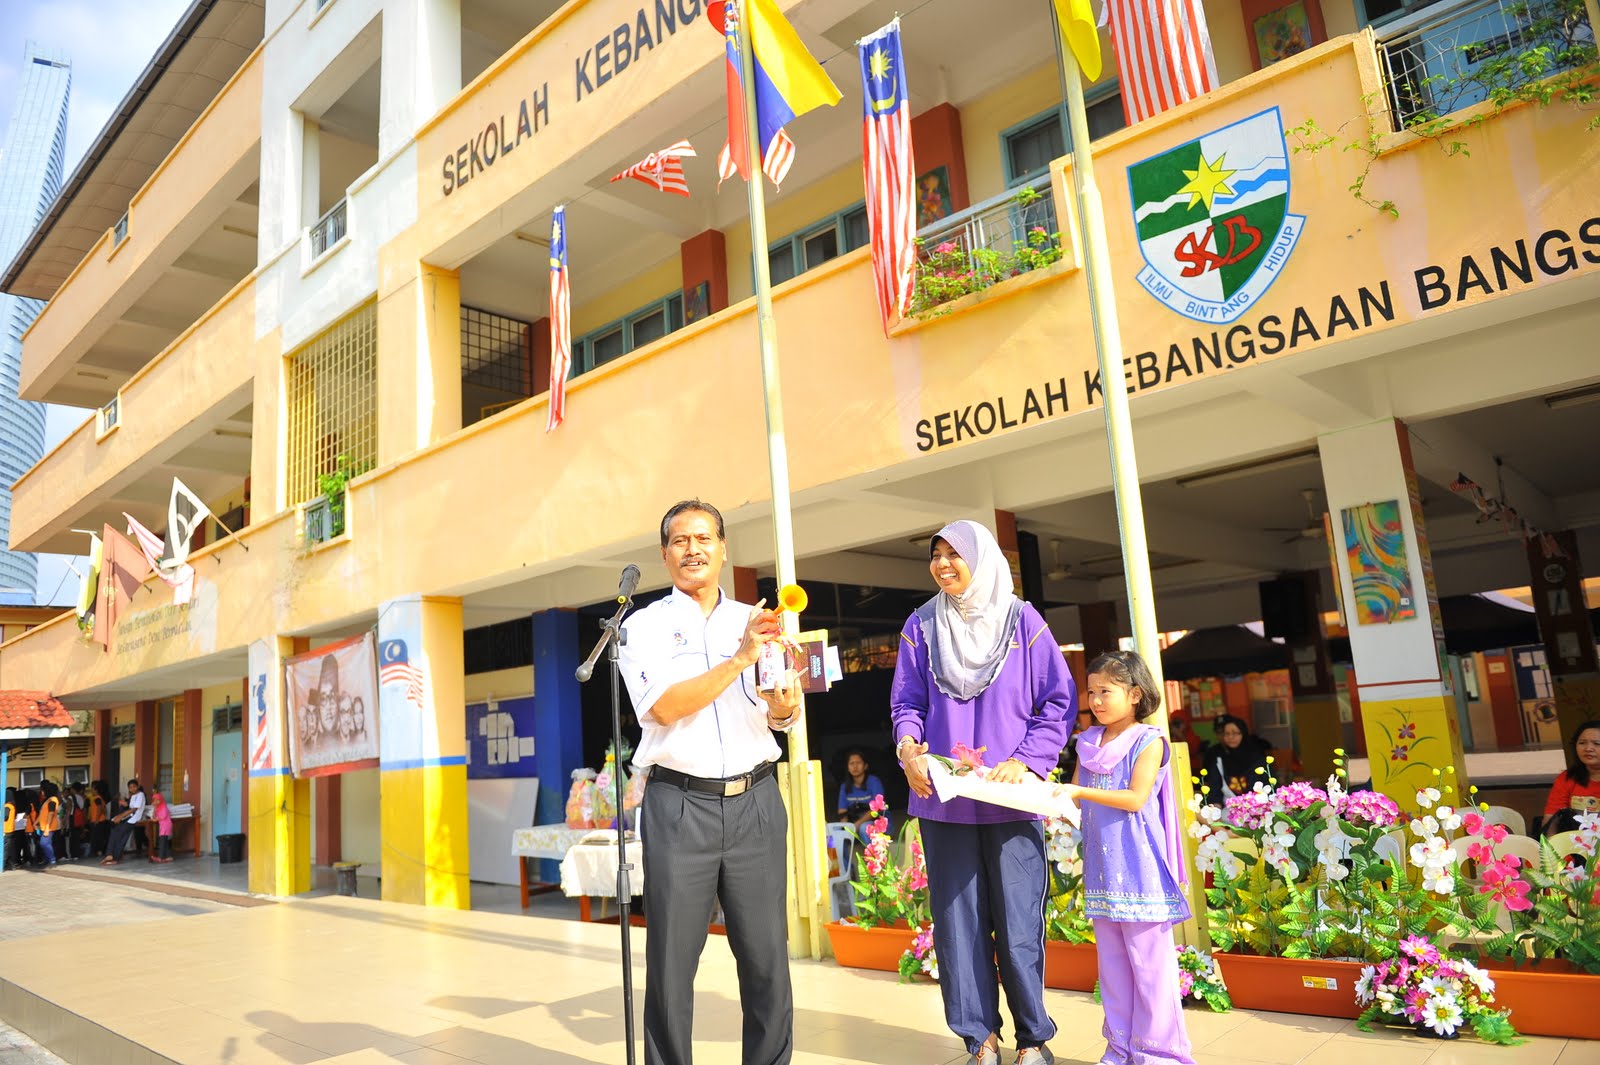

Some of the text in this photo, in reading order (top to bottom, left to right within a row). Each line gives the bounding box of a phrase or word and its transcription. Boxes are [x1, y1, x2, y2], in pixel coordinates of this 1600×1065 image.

[442, 0, 707, 197] SEKOLAH KEBANG
[1144, 273, 1173, 300] ILMU
[1263, 225, 1296, 272] HIDUP
[915, 377, 1070, 452] SEKOLAH
